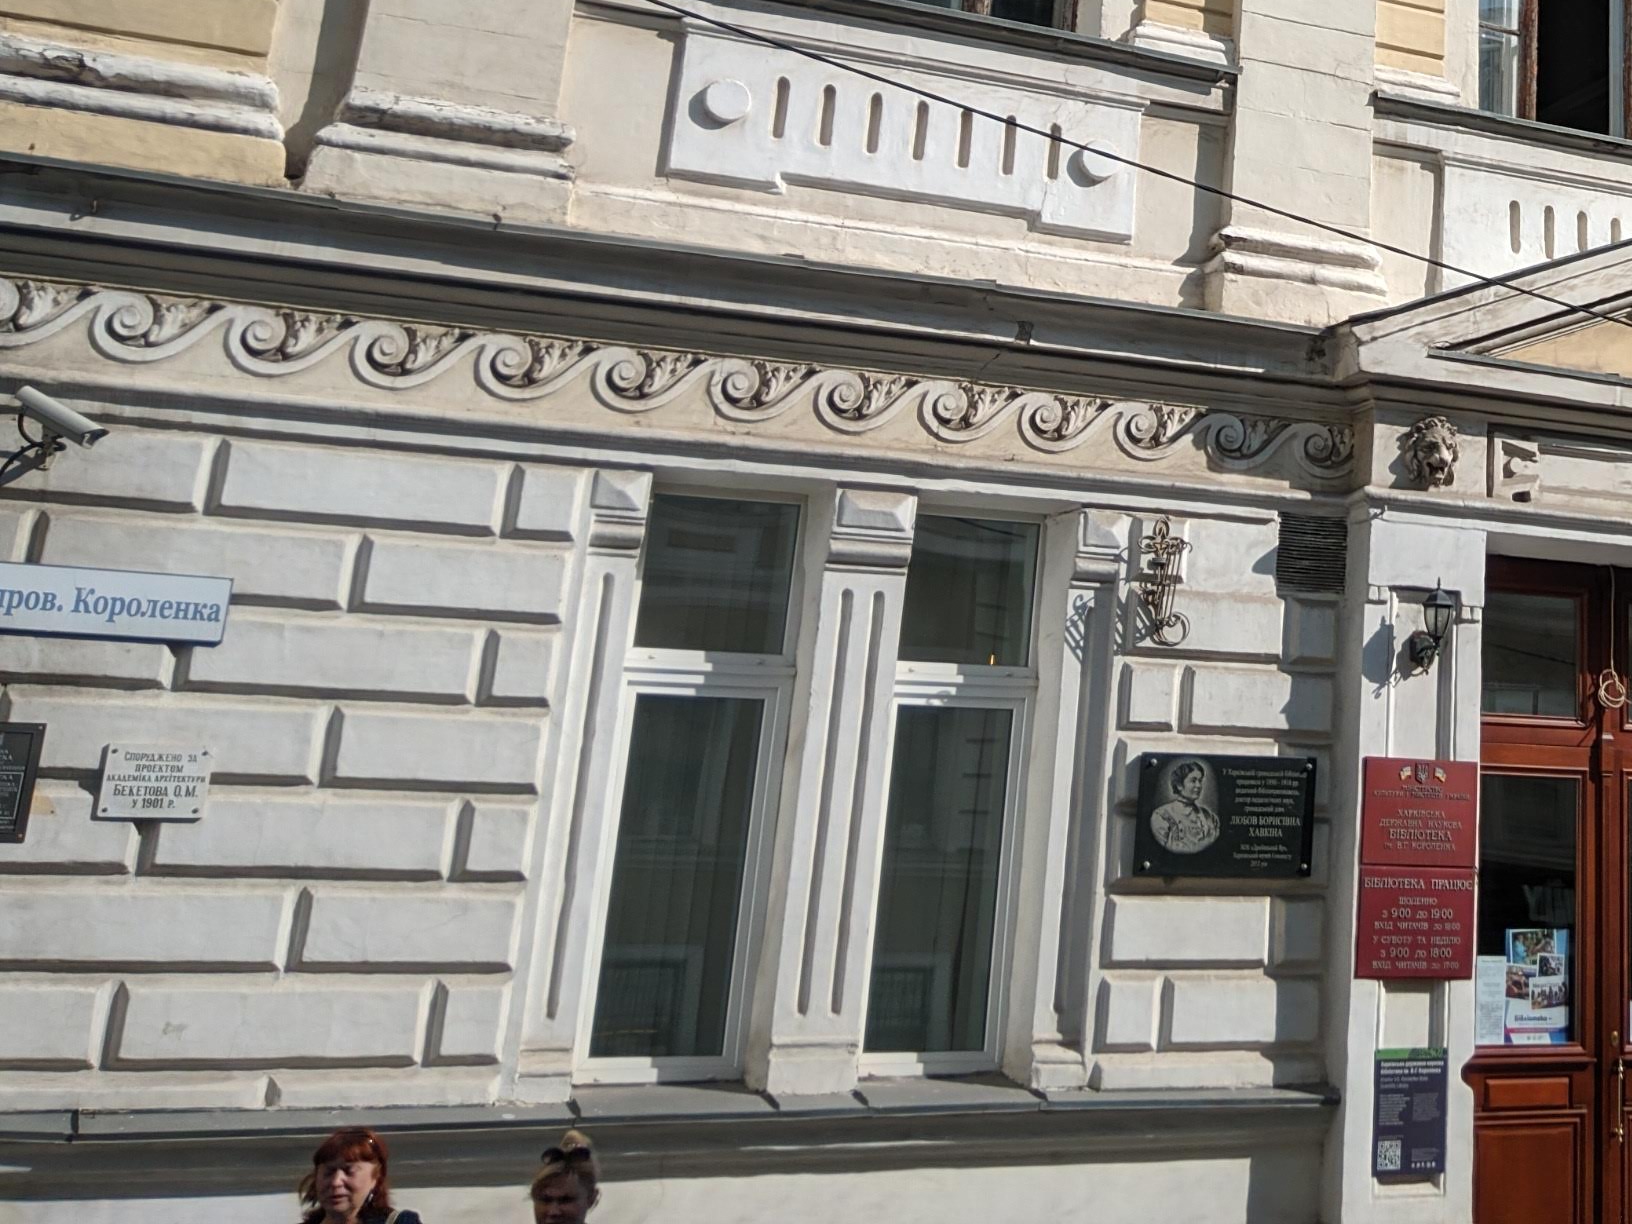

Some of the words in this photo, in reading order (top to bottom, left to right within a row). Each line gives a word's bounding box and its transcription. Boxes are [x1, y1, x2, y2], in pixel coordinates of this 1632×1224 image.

[71, 586, 221, 623] Короленка
[134, 763, 184, 773] ПРОЕКТОМ
[113, 784, 169, 797] БЕКЕТОВА
[142, 797, 164, 808] 1901
[1398, 808, 1446, 818] ХАРКІВСЬКА
[1230, 815, 1258, 825] ЛЮБОВ
[1379, 818, 1423, 828] ДЕРЖАВНА
[1428, 820, 1463, 830] НАУКОВА
[1248, 827, 1283, 837] ХАВКІНА
[1389, 828, 1452, 841] БІБЛІОТЕКА
[1364, 876, 1425, 890] БІБЛІОТЕКА
[1431, 878, 1473, 891] ПРАЦЮЄ
